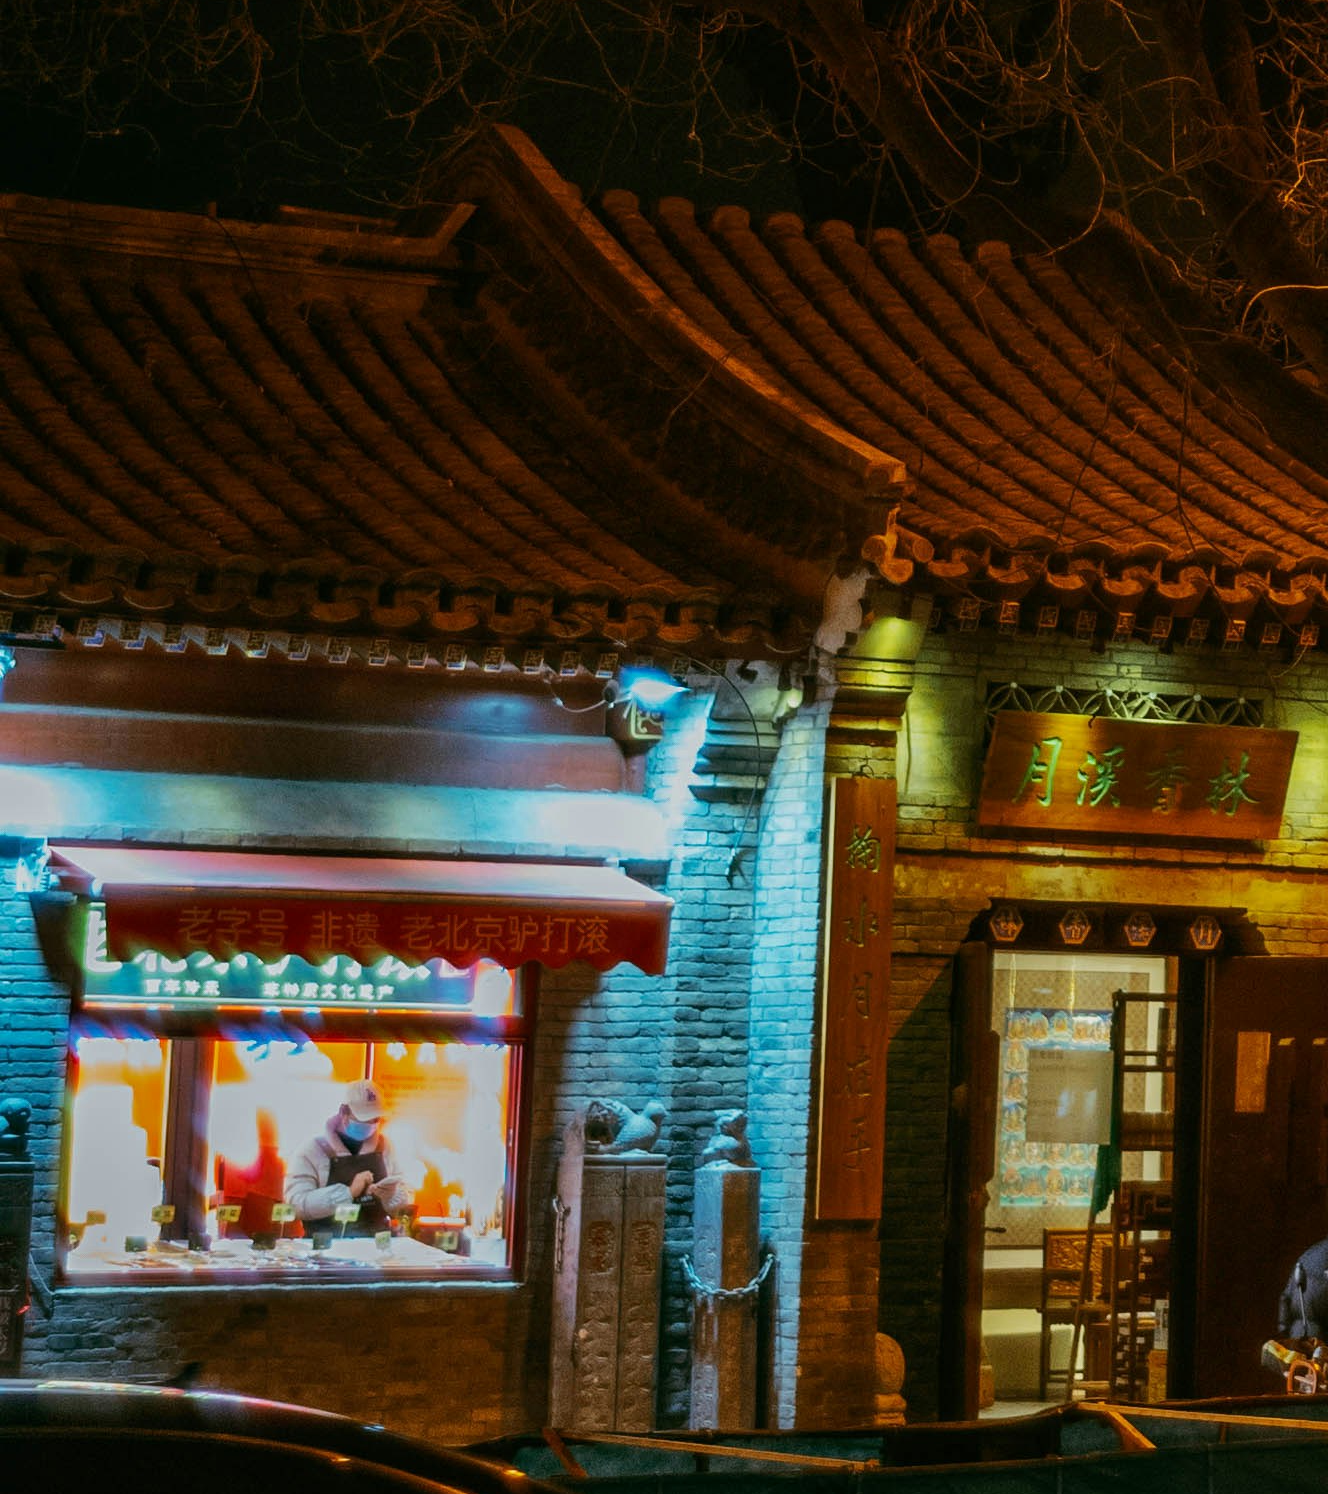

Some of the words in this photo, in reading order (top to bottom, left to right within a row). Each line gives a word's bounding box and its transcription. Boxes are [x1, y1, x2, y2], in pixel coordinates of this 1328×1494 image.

[1011, 735, 1261, 817] 月溪香林
[178, 907, 288, 948] 老字号
[310, 911, 381, 950] 非遗
[400, 914, 612, 956] 老北京驴打滚
